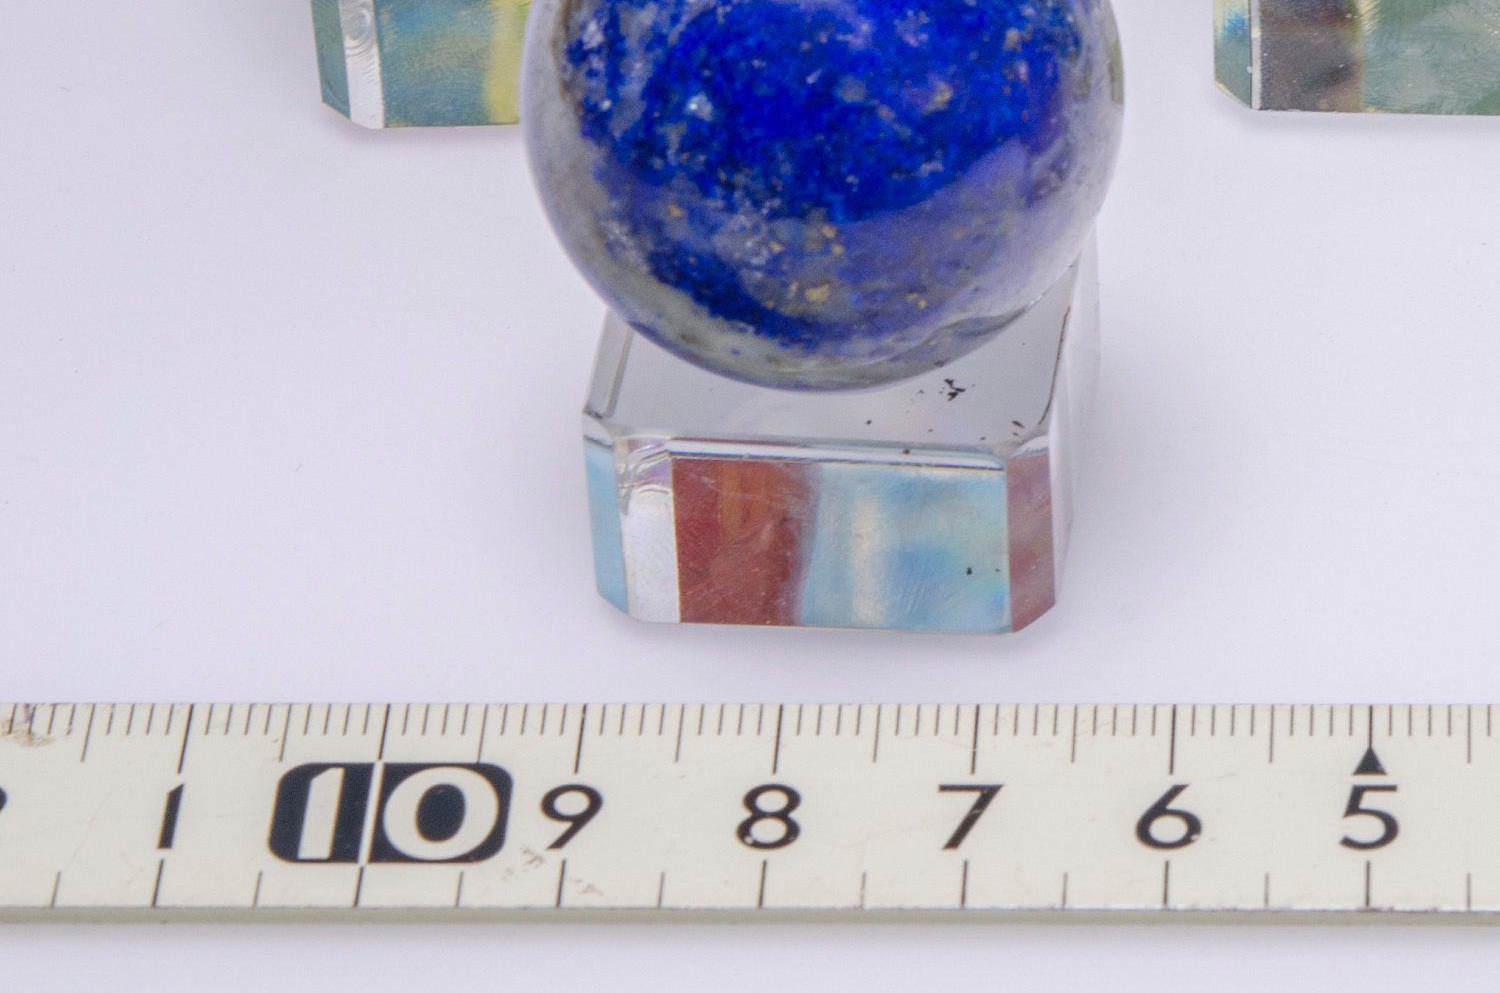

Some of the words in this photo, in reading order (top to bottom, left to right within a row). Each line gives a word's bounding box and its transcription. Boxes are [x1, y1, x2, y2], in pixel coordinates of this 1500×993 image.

[157, 783, 184, 849] 1
[296, 765, 501, 861] 10
[541, 784, 604, 849] 9
[736, 784, 801, 850] 8
[939, 784, 1003, 849] 7
[1136, 784, 1202, 850] 6
[1340, 785, 1398, 850] 5
